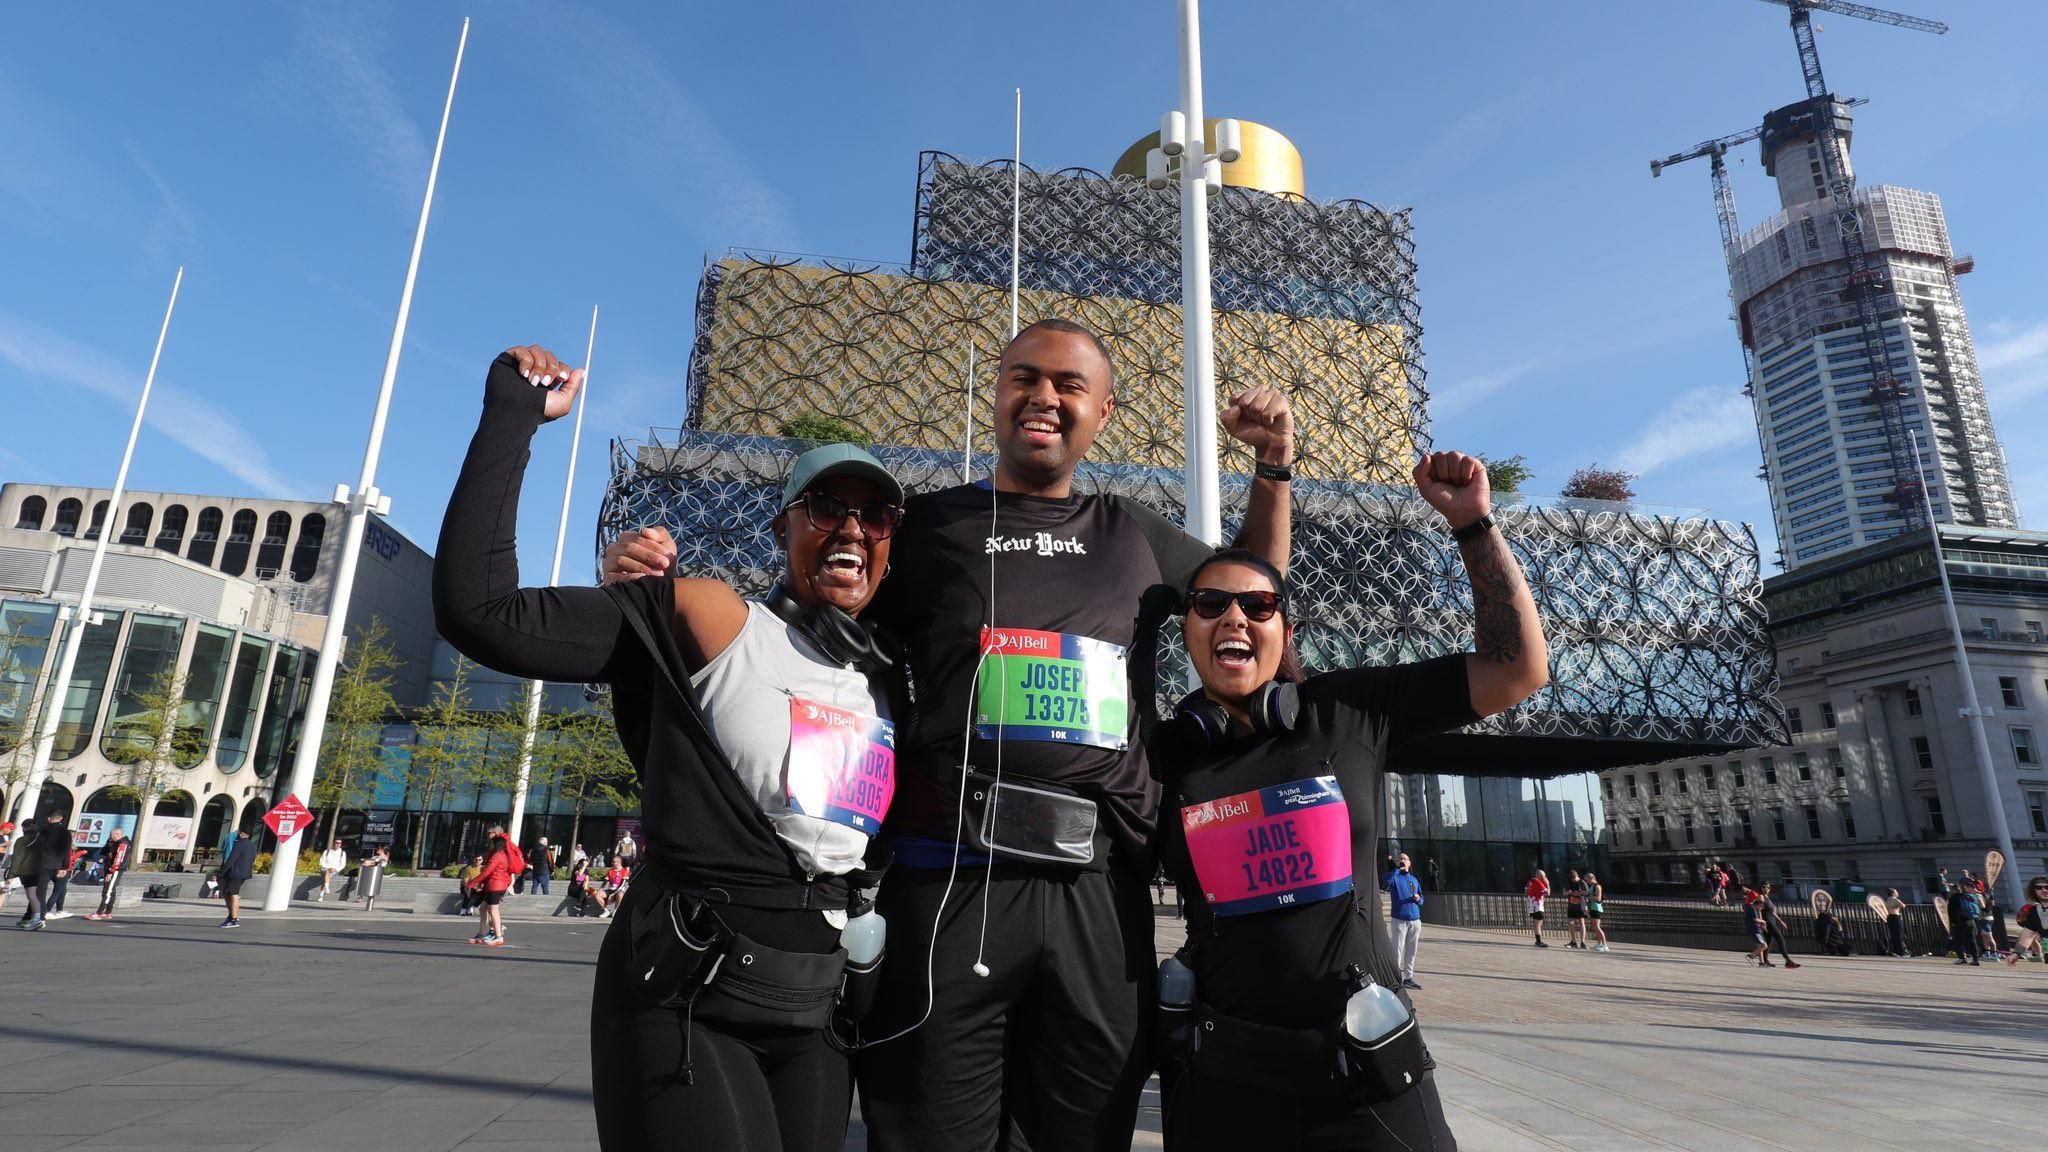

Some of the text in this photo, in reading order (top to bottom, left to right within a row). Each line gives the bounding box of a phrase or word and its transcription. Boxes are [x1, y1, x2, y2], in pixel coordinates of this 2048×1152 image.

[986, 532, 1087, 557] New York
[1020, 662, 1087, 693] JOSEP
[1025, 693, 1090, 724] 13375
[1051, 730, 1067, 739] 10K
[1246, 819, 1300, 857] JADE
[1242, 851, 1318, 893] 14822
[1277, 893, 1296, 905] 10K
